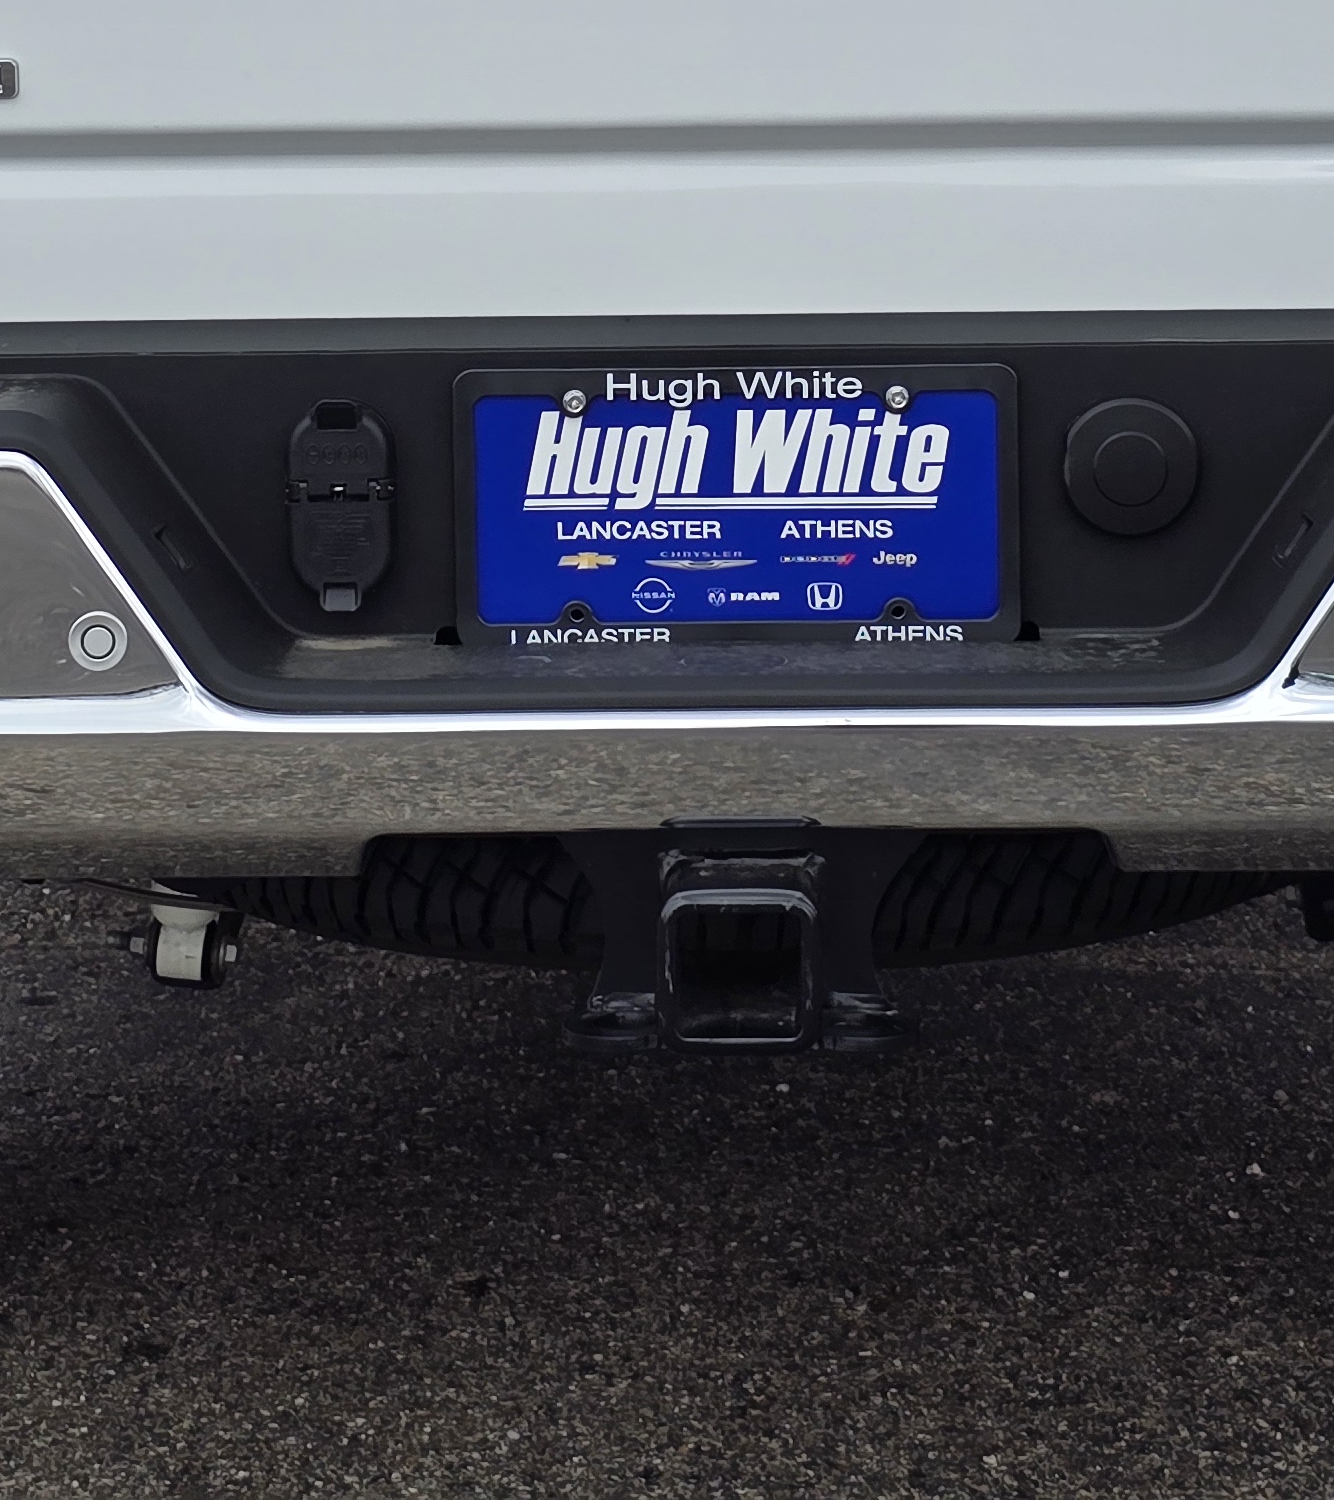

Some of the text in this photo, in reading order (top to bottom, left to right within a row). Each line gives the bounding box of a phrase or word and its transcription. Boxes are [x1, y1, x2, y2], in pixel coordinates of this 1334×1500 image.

[606, 371, 863, 407] Hugh White
[525, 408, 950, 510] Hugh White
[556, 520, 722, 540] LANCASTER
[780, 519, 894, 539] ATHENS
[872, 550, 918, 567] Jeep
